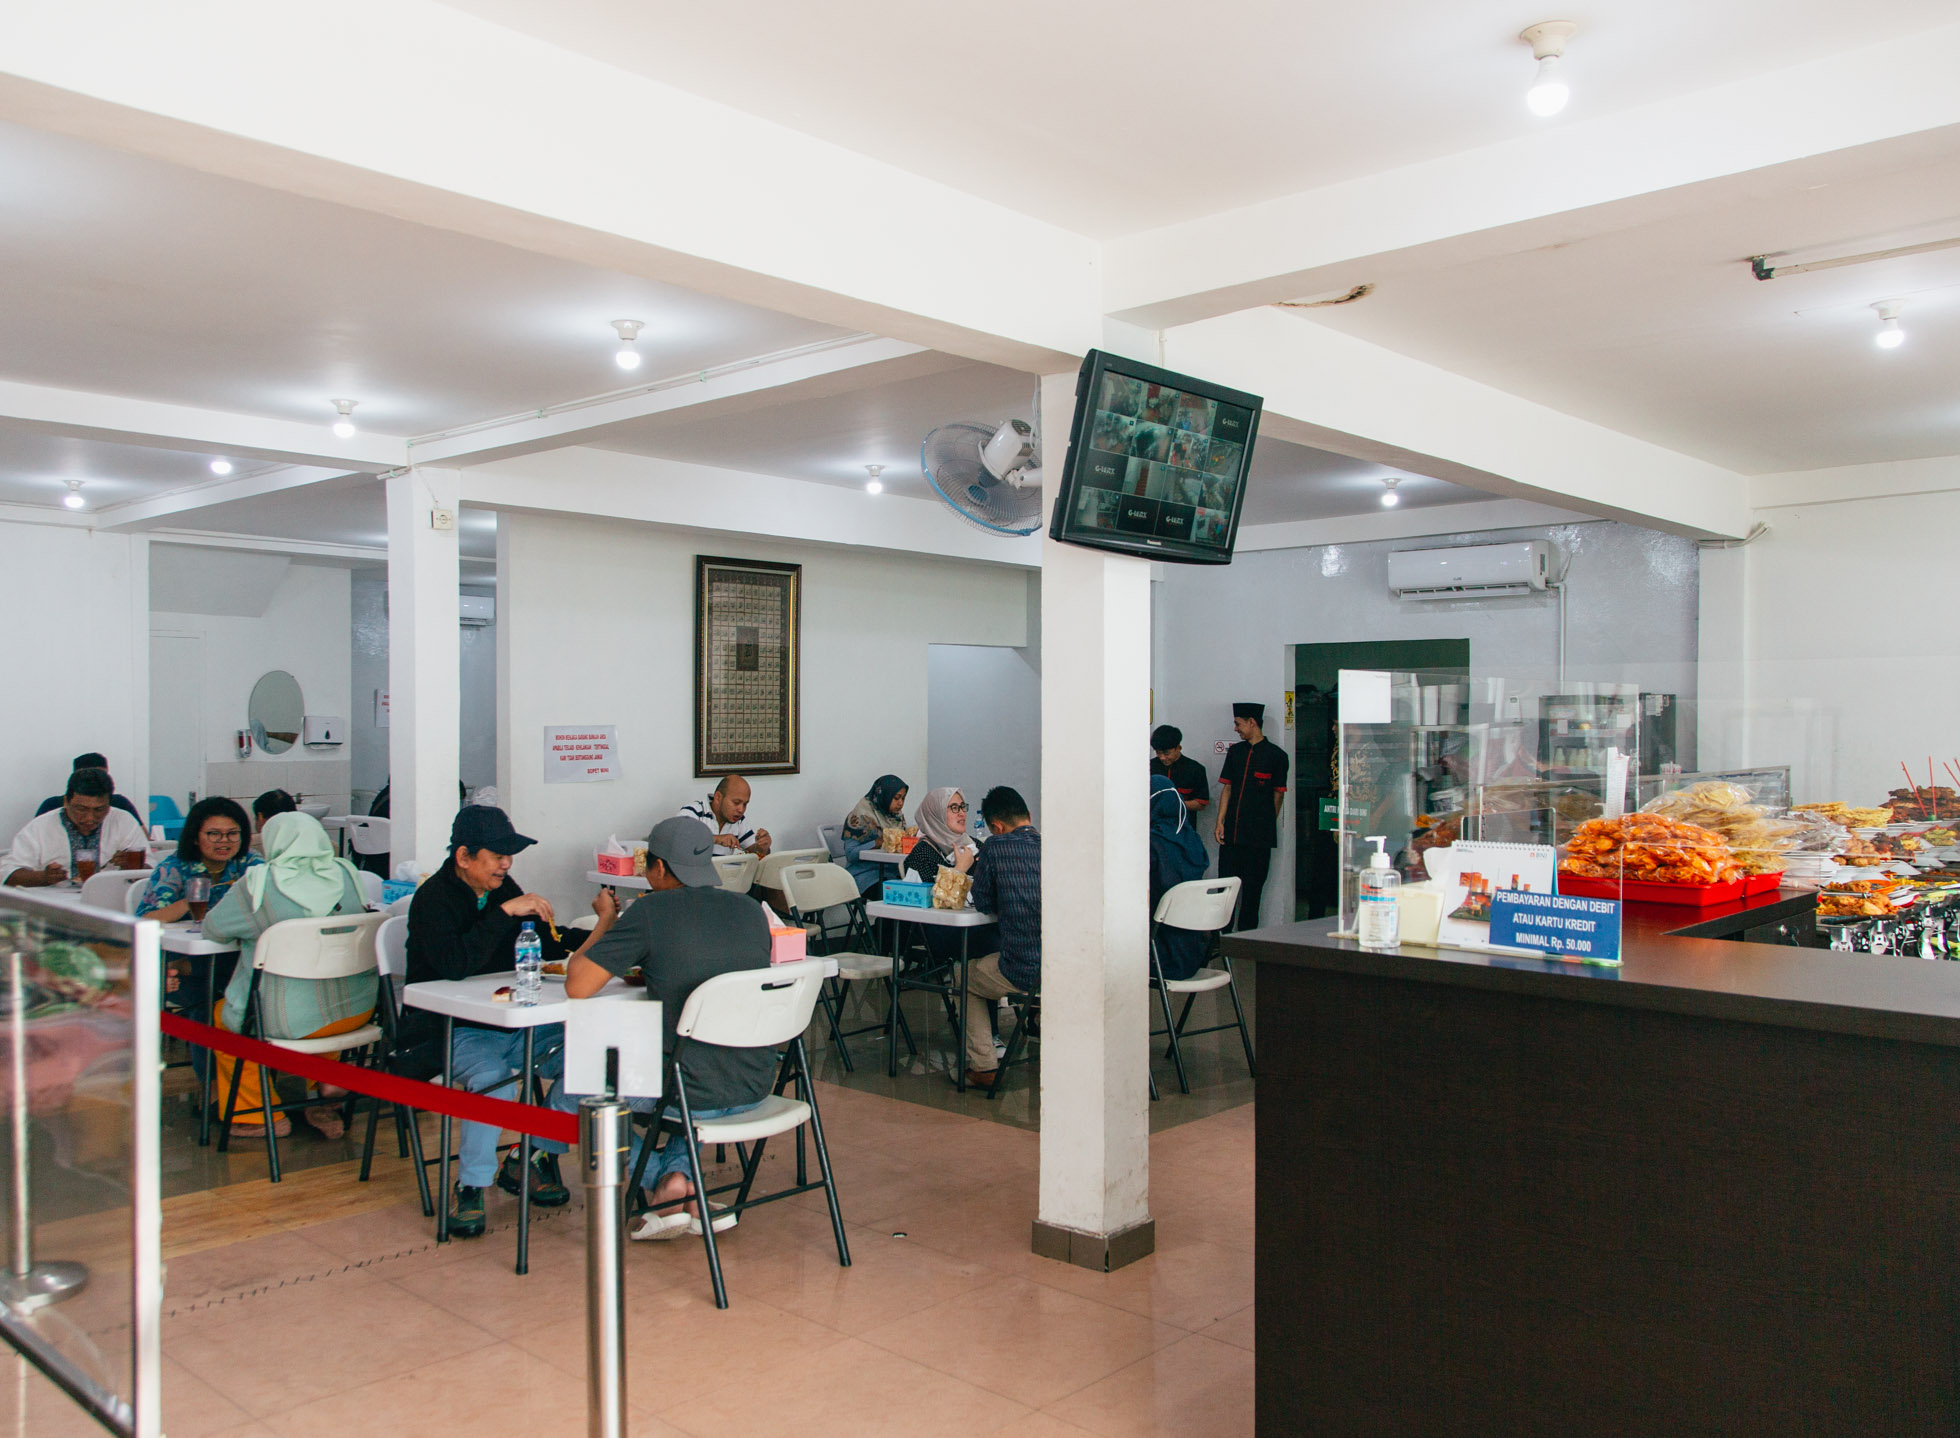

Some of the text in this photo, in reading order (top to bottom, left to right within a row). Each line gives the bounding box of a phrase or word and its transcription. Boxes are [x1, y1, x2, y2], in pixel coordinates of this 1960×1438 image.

[1497, 892, 1615, 914] PEMBAYARAN DENGAN DEBIT
[1513, 912, 1596, 932] ATAU KARTU KREDIT
[1516, 932, 1592, 952] MINIMAL Rp. 50.000
